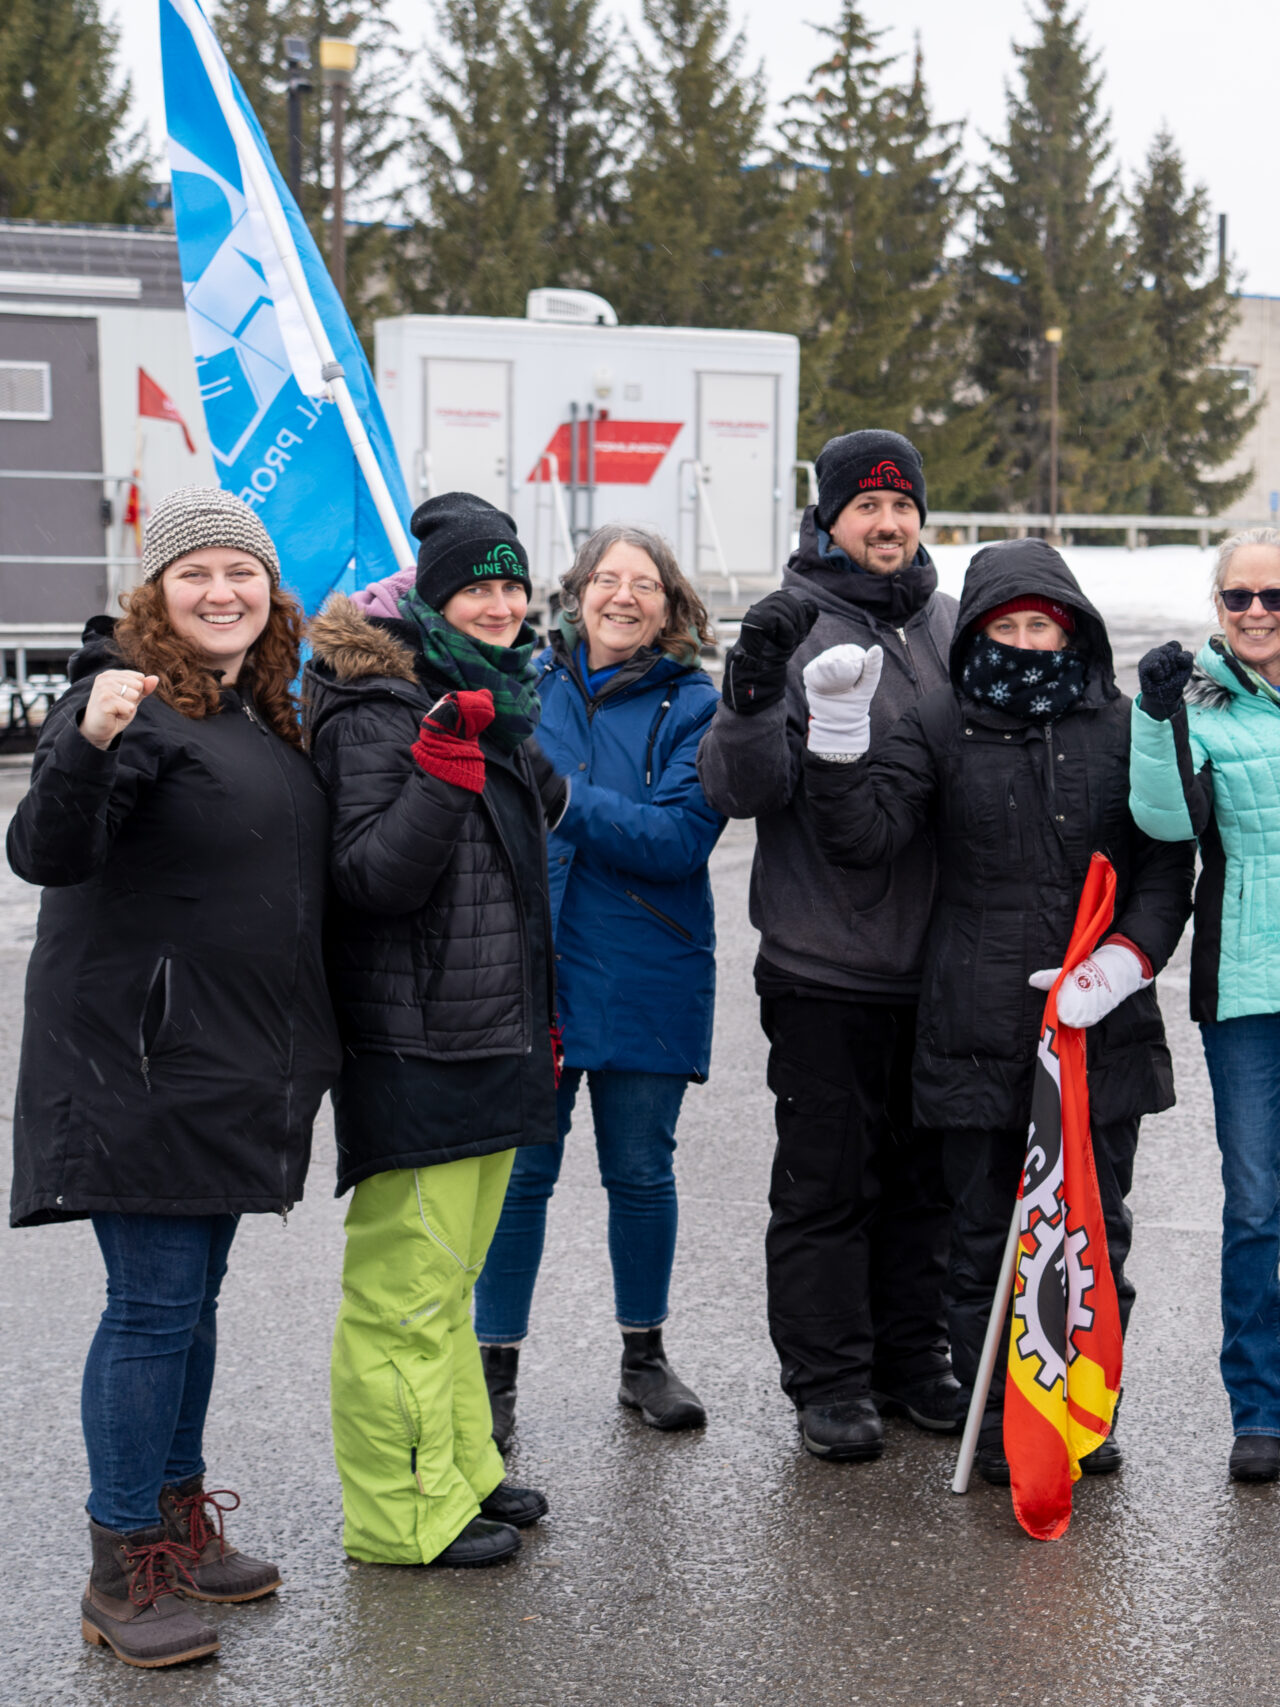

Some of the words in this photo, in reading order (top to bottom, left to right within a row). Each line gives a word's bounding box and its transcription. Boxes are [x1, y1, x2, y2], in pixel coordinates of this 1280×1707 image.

[859, 477, 884, 489] UNE
[894, 478, 913, 490] SEN
[473, 562, 503, 576] UNE
